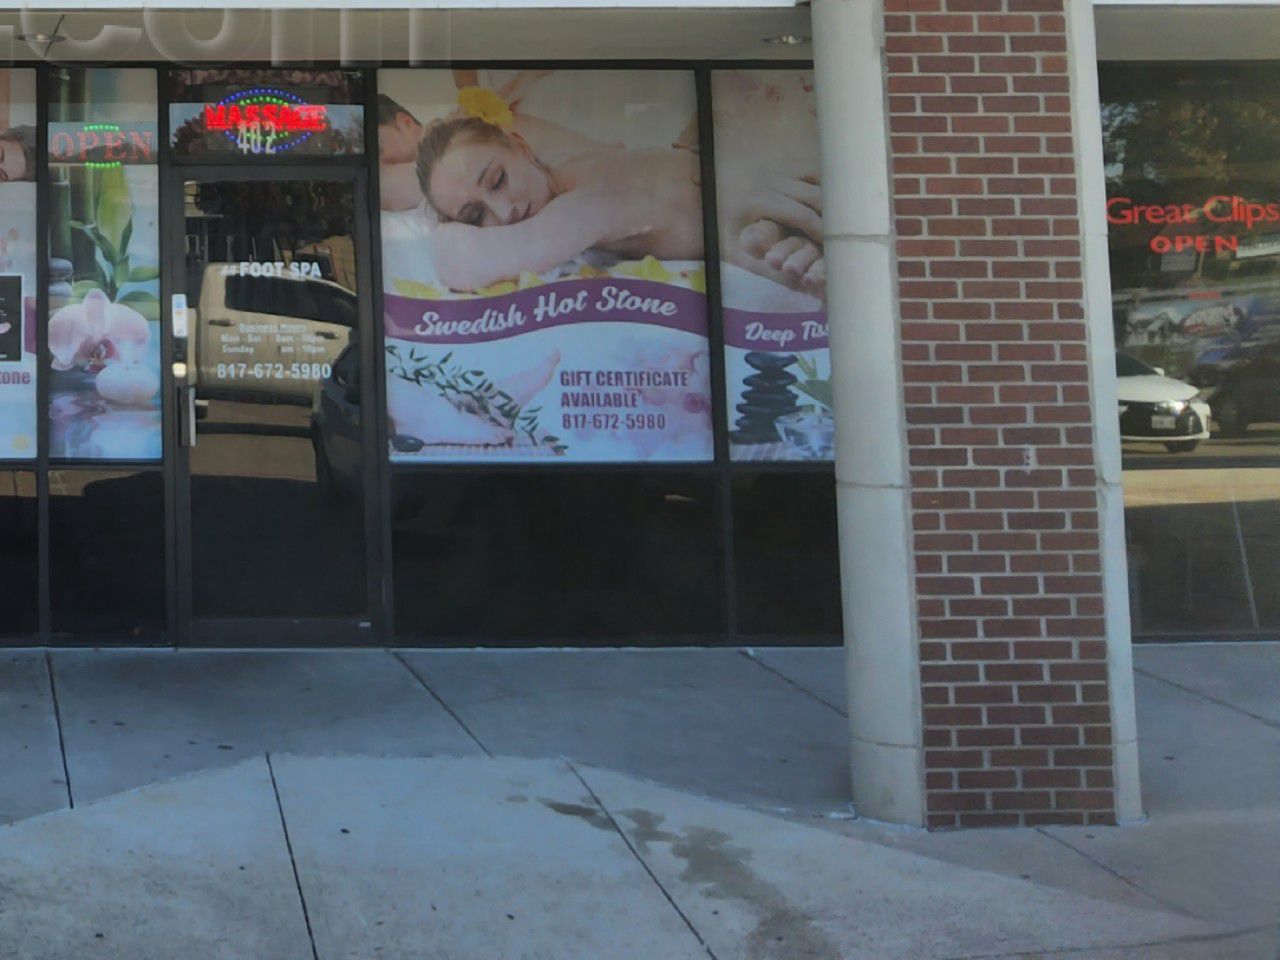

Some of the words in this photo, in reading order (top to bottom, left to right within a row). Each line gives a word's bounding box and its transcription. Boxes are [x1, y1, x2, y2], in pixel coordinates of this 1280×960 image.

[51, 131, 154, 161] OPEN
[237, 121, 276, 154] 402
[1105, 197, 1197, 224] Great
[1203, 195, 1280, 230] Clips
[1149, 235, 1239, 254] OPEN
[240, 262, 284, 277] FOOT
[289, 262, 322, 277] SPA
[414, 310, 525, 336] Swedish
[533, 290, 588, 323] Hot
[595, 286, 679, 317] Stone
[745, 321, 796, 347] Deep
[560, 370, 592, 386] GIFT
[595, 370, 689, 387] CERTIFICATE
[561, 391, 638, 408] AVAILABLE
[562, 413, 666, 430] 817-672-5980
